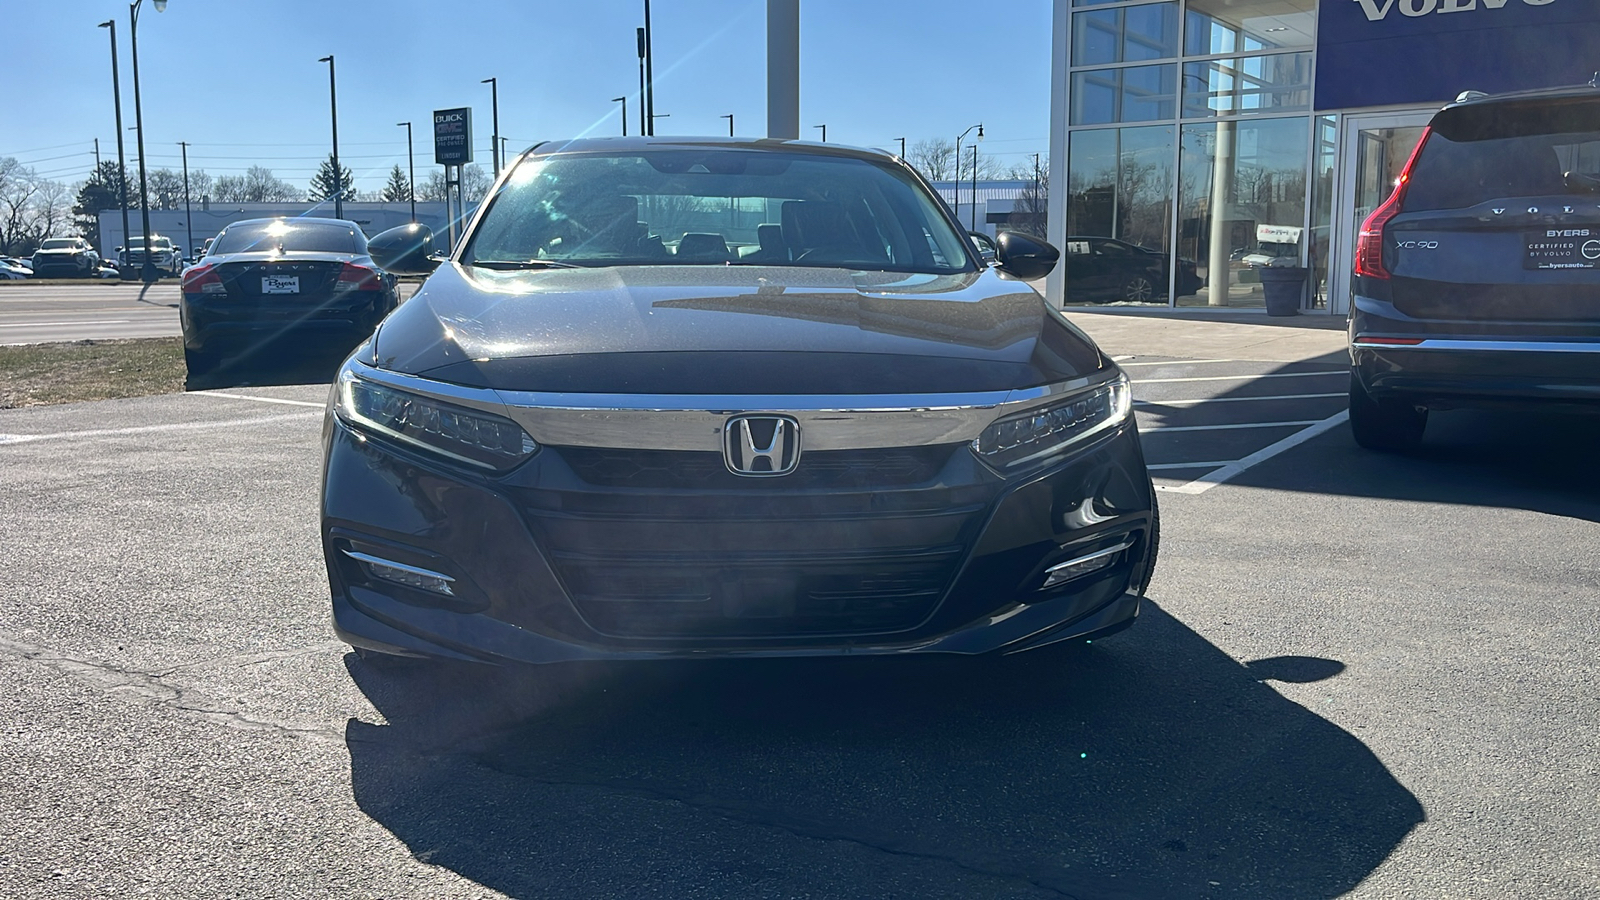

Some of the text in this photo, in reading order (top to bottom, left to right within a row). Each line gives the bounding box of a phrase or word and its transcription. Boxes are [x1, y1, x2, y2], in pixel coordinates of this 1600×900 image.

[1353, 0, 1555, 21] VOL
[436, 114, 462, 123] BUICK
[436, 122, 462, 133] GMC
[1491, 205, 1600, 215] VOL
[1546, 229, 1590, 237] BYERS
